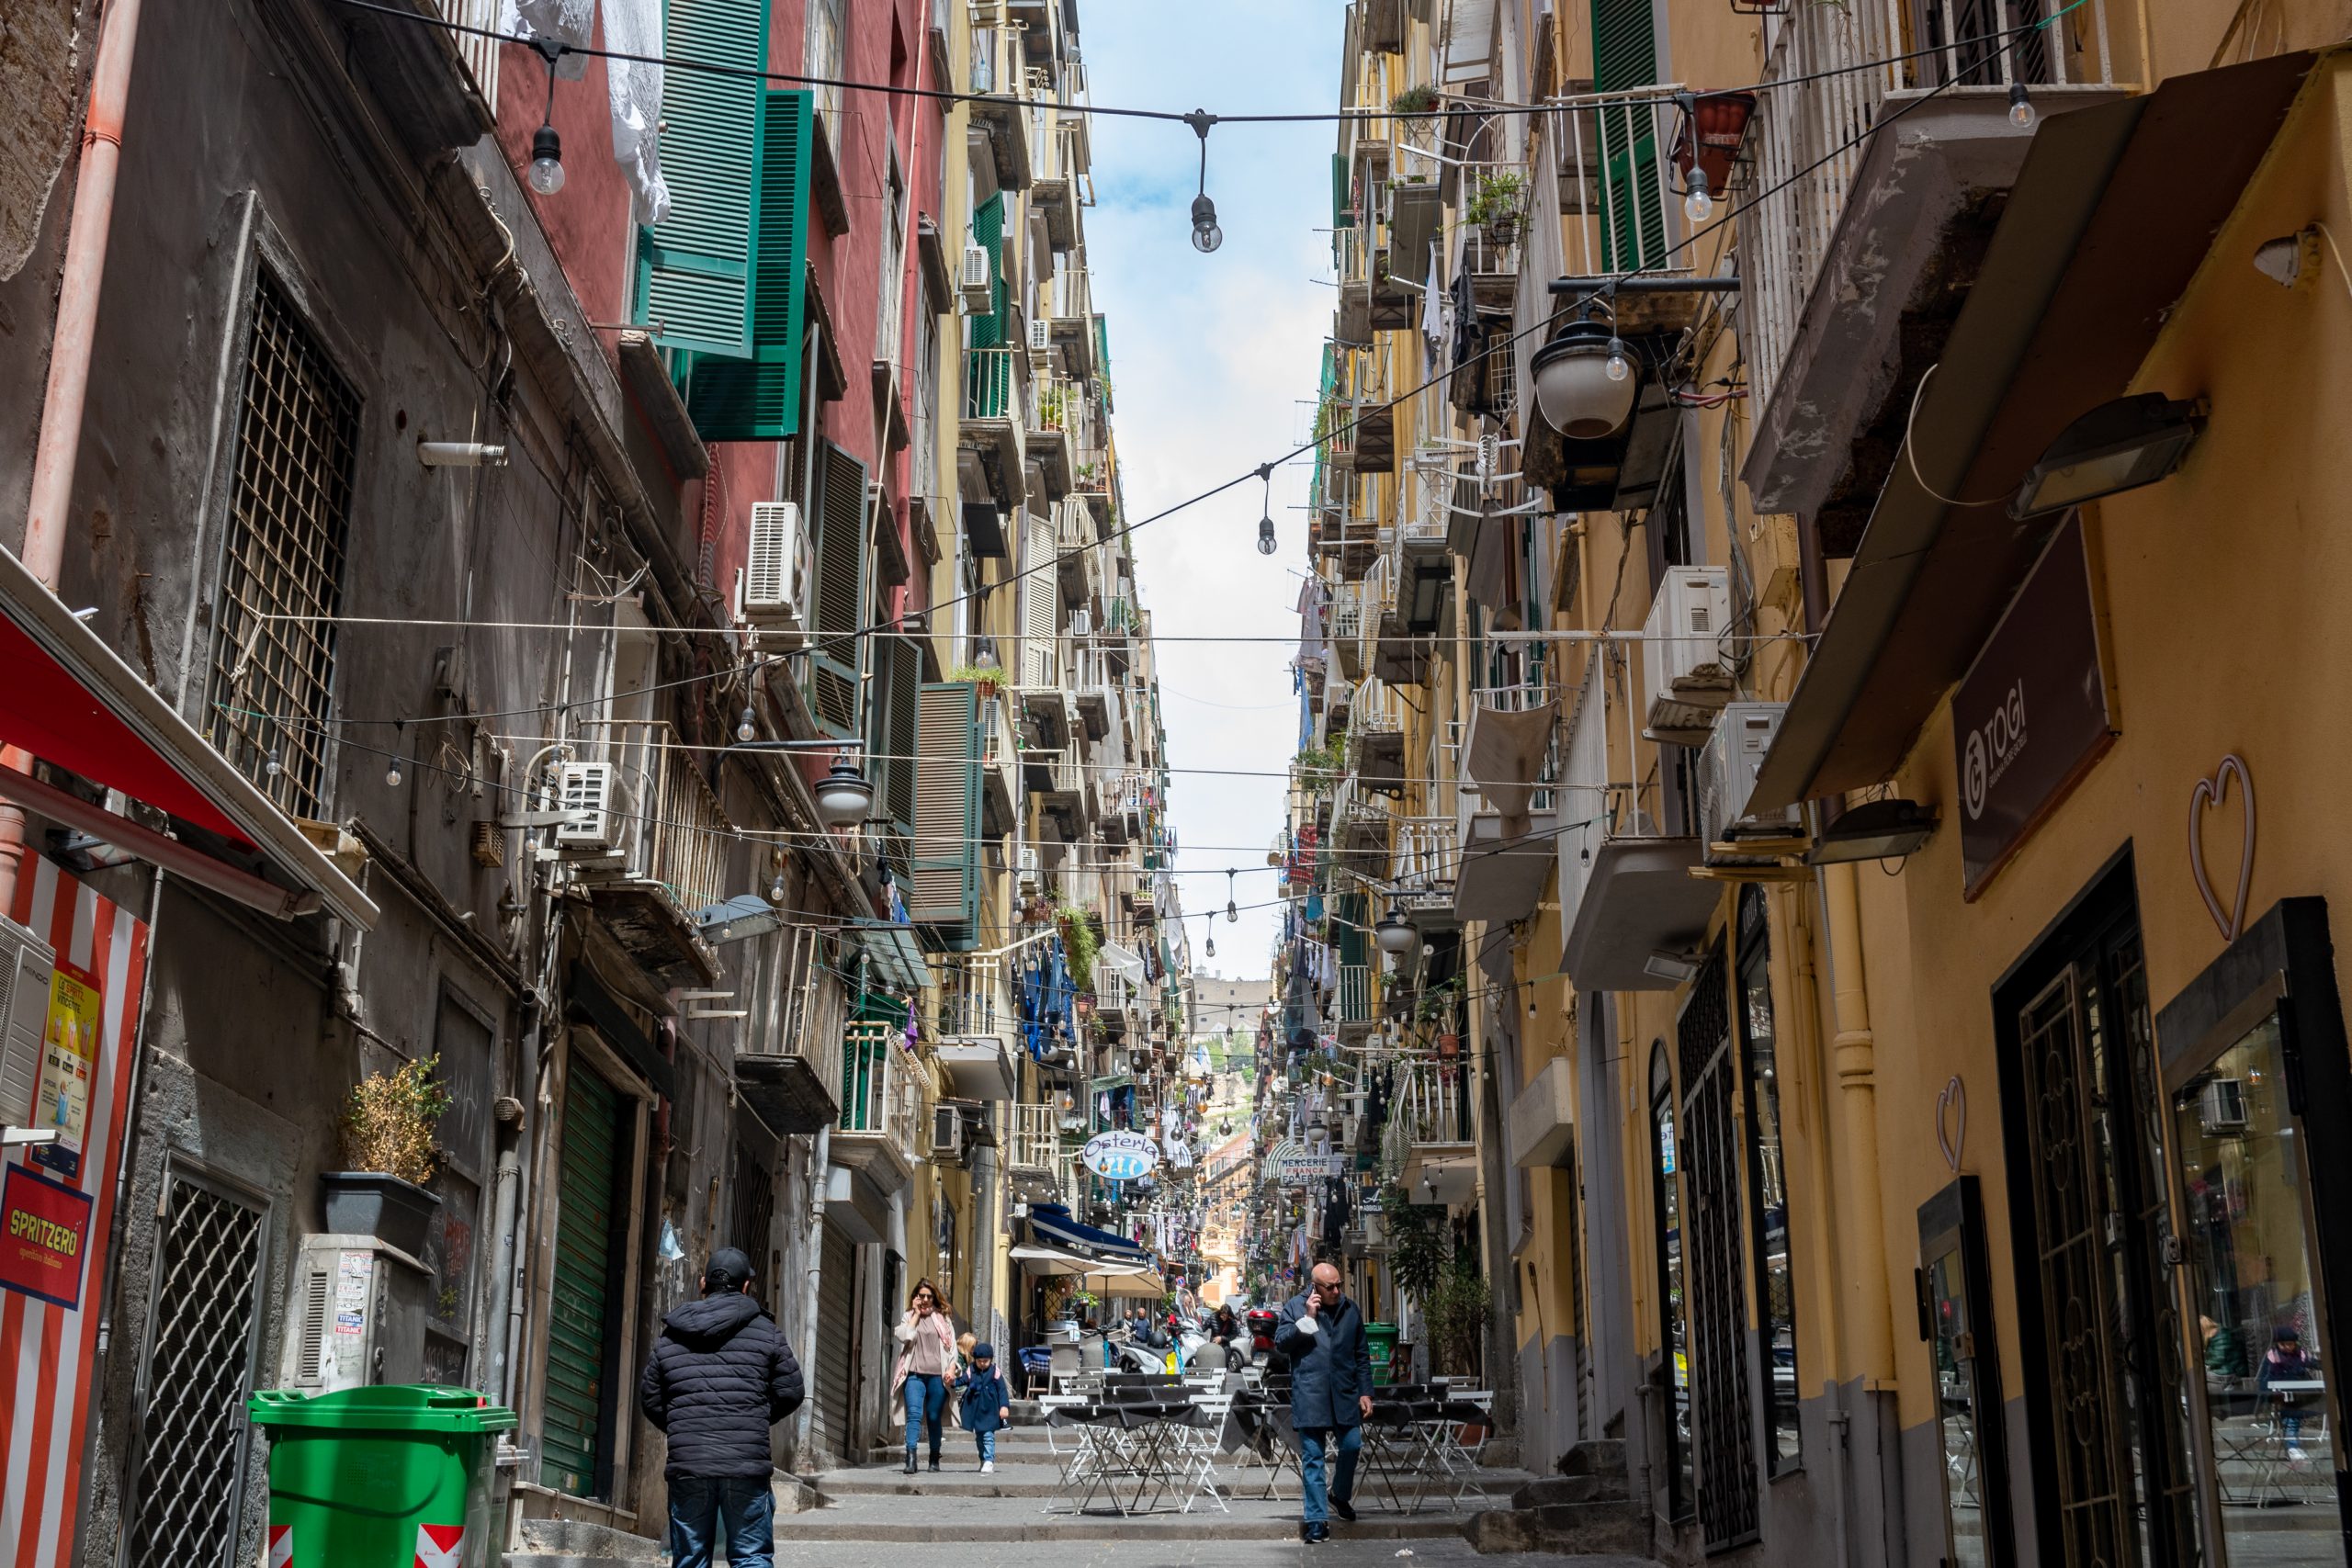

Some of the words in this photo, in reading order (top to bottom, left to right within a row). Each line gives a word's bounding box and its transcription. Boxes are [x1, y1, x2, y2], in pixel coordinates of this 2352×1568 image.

[1984, 678, 2026, 770] TOGI
[22, 963, 49, 986] KENDO
[1084, 1134, 1158, 1158] Osteria
[1283, 1158, 1328, 1168] MERCERIE
[1286, 1168, 1324, 1176] FRANCA
[10, 1208, 78, 1257] SPRITZERO
[339, 1314, 363, 1324] TITANIC
[337, 1325, 360, 1334] TITANIC
